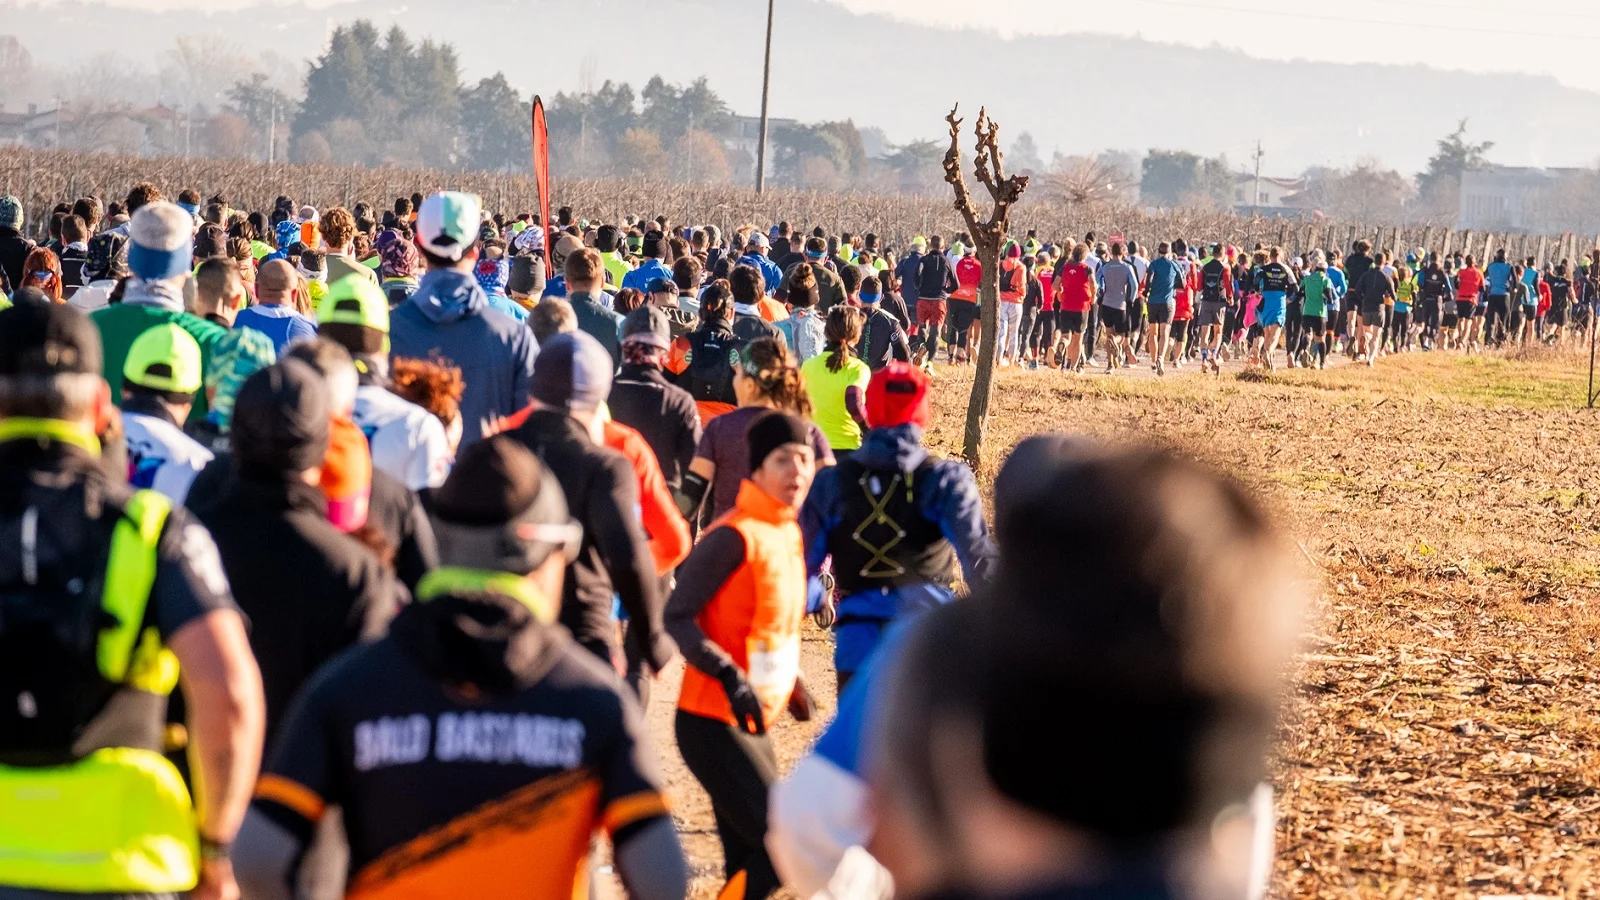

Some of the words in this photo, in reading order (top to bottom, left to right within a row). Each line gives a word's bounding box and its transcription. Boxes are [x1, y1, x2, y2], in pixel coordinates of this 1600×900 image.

[861, 324, 871, 362] lpenplus
[354, 713, 431, 771] BALD
[435, 711, 586, 769] BASTARDS
